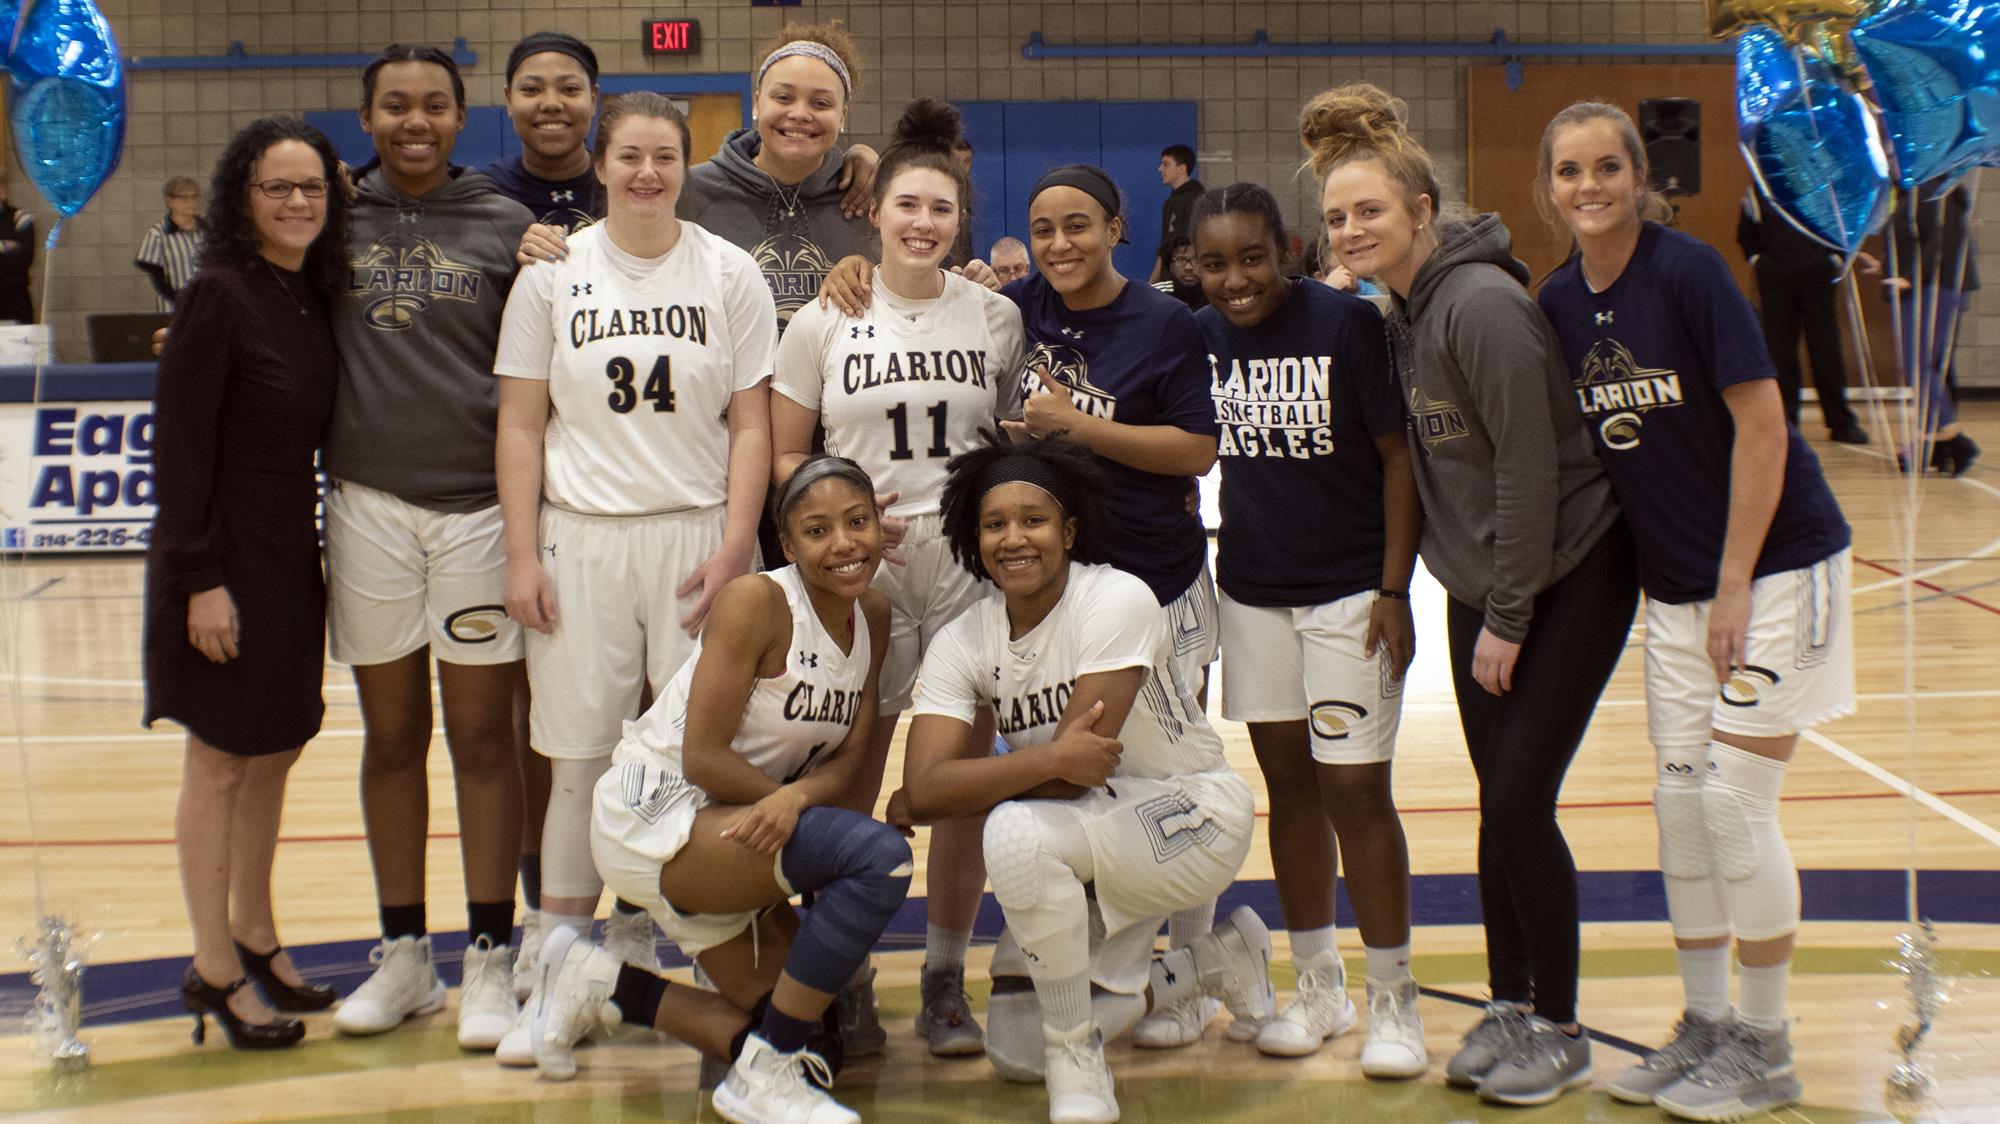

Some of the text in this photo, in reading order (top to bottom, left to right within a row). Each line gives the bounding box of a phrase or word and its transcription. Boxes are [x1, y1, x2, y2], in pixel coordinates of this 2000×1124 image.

[652, 22, 690, 50] EXIT
[570, 304, 707, 349] CLARION
[605, 354, 676, 414] 34
[843, 349, 987, 395] CLARION
[885, 400, 951, 461] 11
[1212, 400, 1328, 426] SKETBALL
[991, 678, 1076, 735] LARIO
